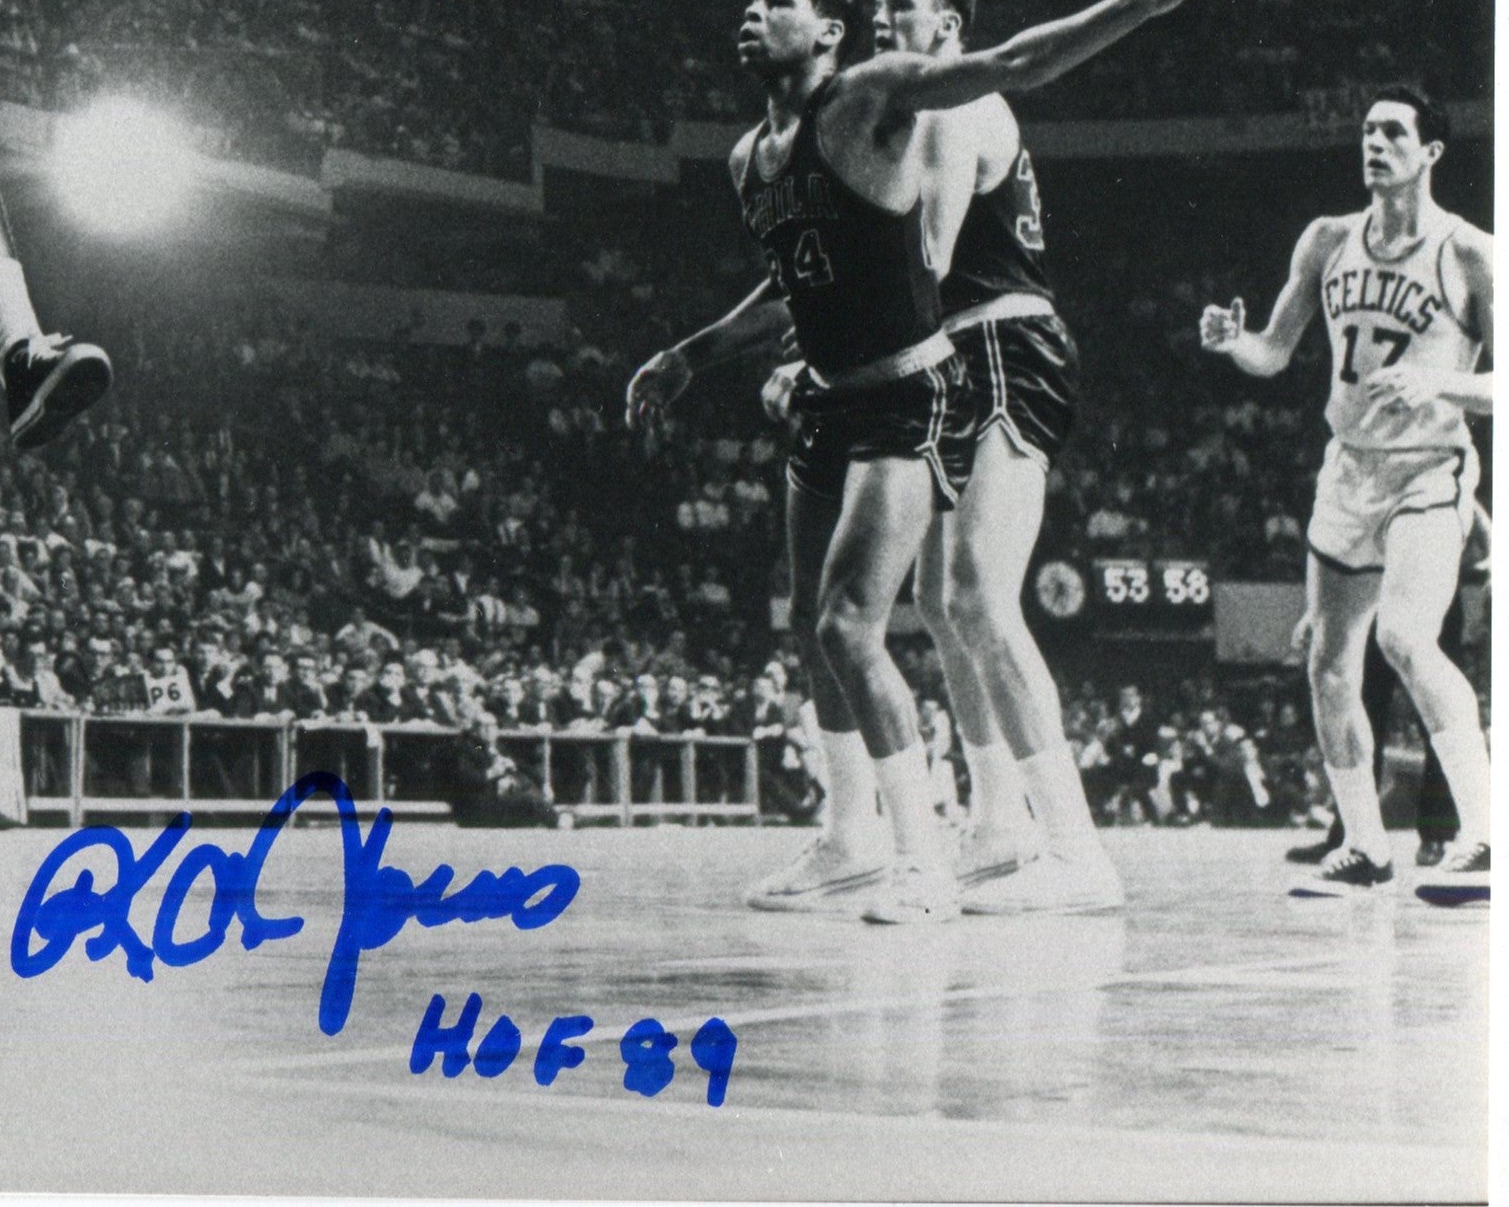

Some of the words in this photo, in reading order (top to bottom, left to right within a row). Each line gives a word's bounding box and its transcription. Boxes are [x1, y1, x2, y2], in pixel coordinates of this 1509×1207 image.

[1325, 268, 1441, 335] CELTICS
[1340, 324, 1411, 385] 17
[1102, 567, 1148, 603] 53
[411, 992, 596, 1086] HOF
[621, 1018, 739, 1108] 89
